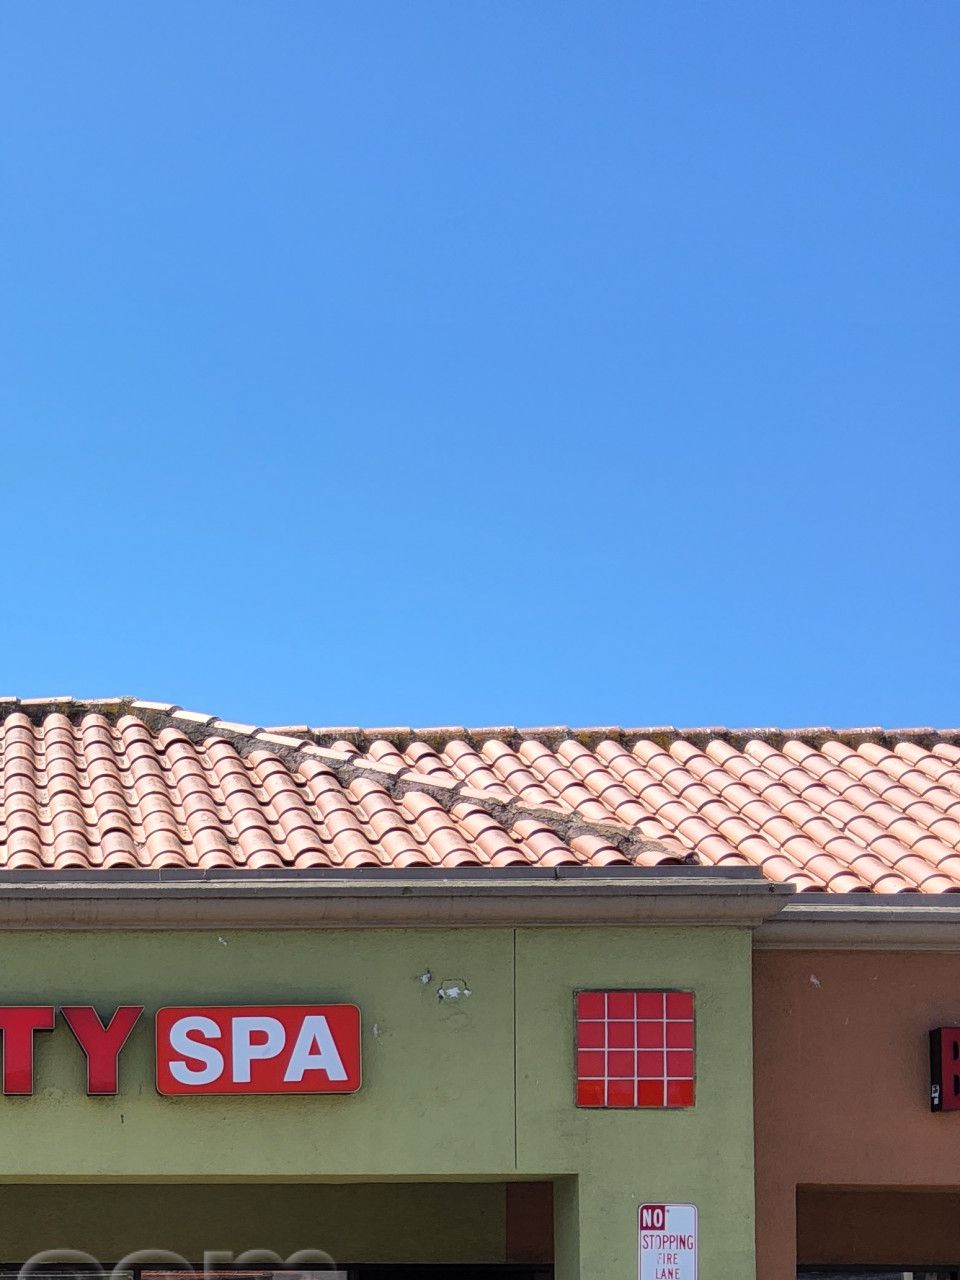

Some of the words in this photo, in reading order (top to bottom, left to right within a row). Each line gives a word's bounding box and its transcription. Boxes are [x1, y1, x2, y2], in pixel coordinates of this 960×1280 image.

[168, 1015, 349, 1087] SPA
[642, 1208, 663, 1228] NO
[642, 1234, 694, 1251] STOPPING
[657, 1253, 678, 1265] FIRE
[655, 1268, 681, 1280] LANE
